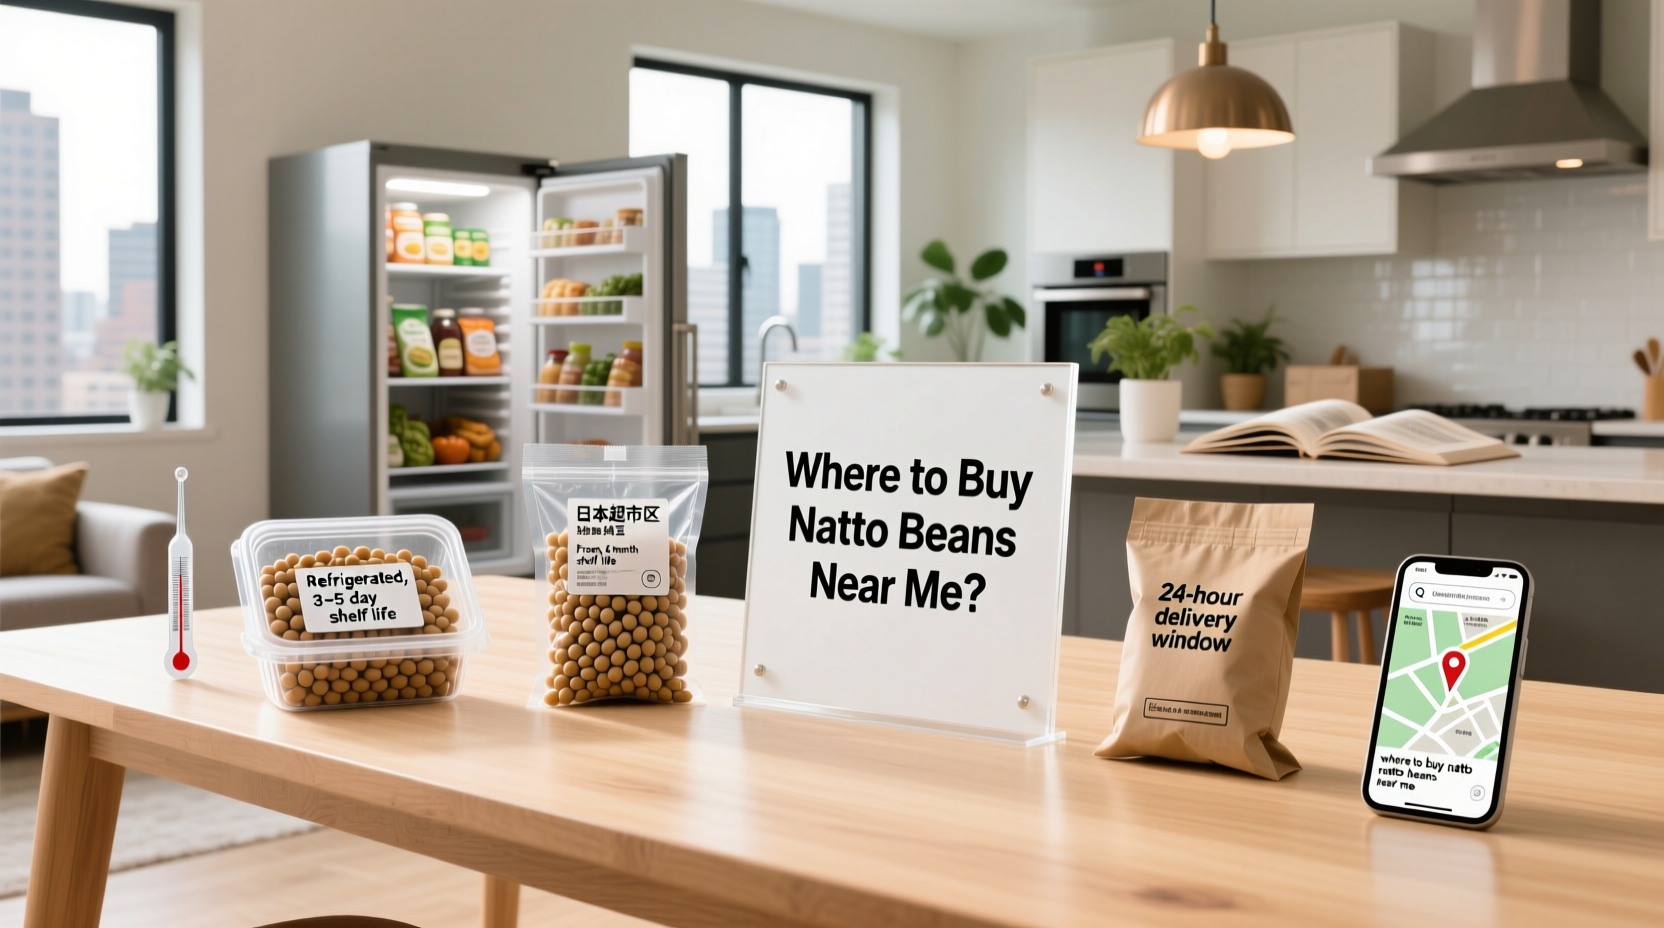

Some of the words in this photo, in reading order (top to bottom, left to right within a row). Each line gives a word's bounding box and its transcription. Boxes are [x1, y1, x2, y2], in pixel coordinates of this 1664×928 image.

[786, 450, 900, 493] Where
[910, 458, 948, 496] to
[958, 458, 1033, 511] Buy
[789, 505, 888, 548] Natto
[898, 511, 1016, 557] Beans
[810, 561, 896, 604] Near
[904, 568, 987, 612] Me?
[1158, 582, 1244, 605] 24-hour
[349, 591, 377, 607] day
[330, 608, 368, 623] shelf
[371, 606, 397, 621] life
[1154, 606, 1237, 633] delivery
[1152, 629, 1232, 652] window
[1413, 757, 1422, 767] to
[1426, 756, 1444, 773] buy
